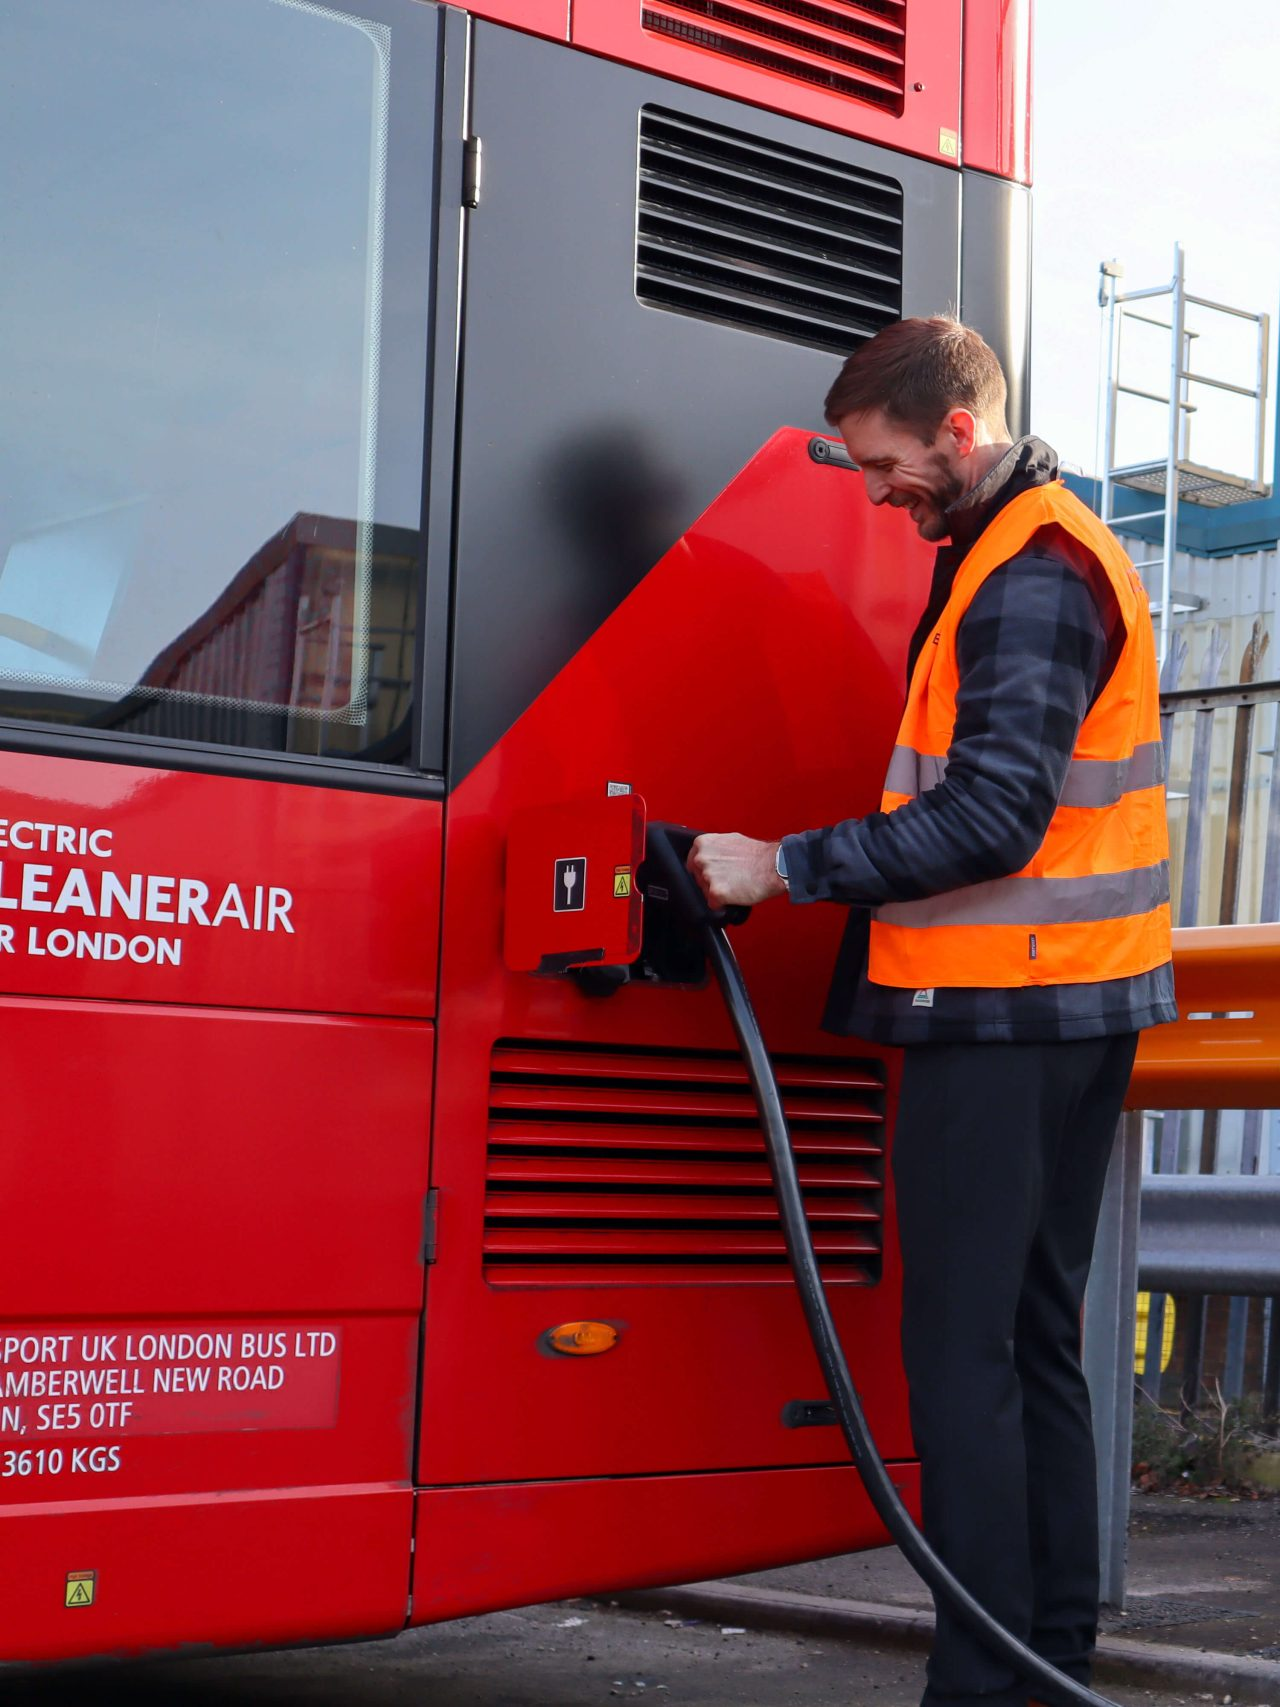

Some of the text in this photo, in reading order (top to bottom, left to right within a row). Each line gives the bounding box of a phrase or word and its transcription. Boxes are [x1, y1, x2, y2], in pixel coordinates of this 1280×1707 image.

[27, 926, 182, 966] LONDON
[0, 1332, 336, 1364] PORT UK LONDON BUS LTD
[0, 1365, 284, 1398] MBERWELL NEW ROAD
[36, 1403, 81, 1431] SE5
[1, 1446, 121, 1477] 3610 KGS
